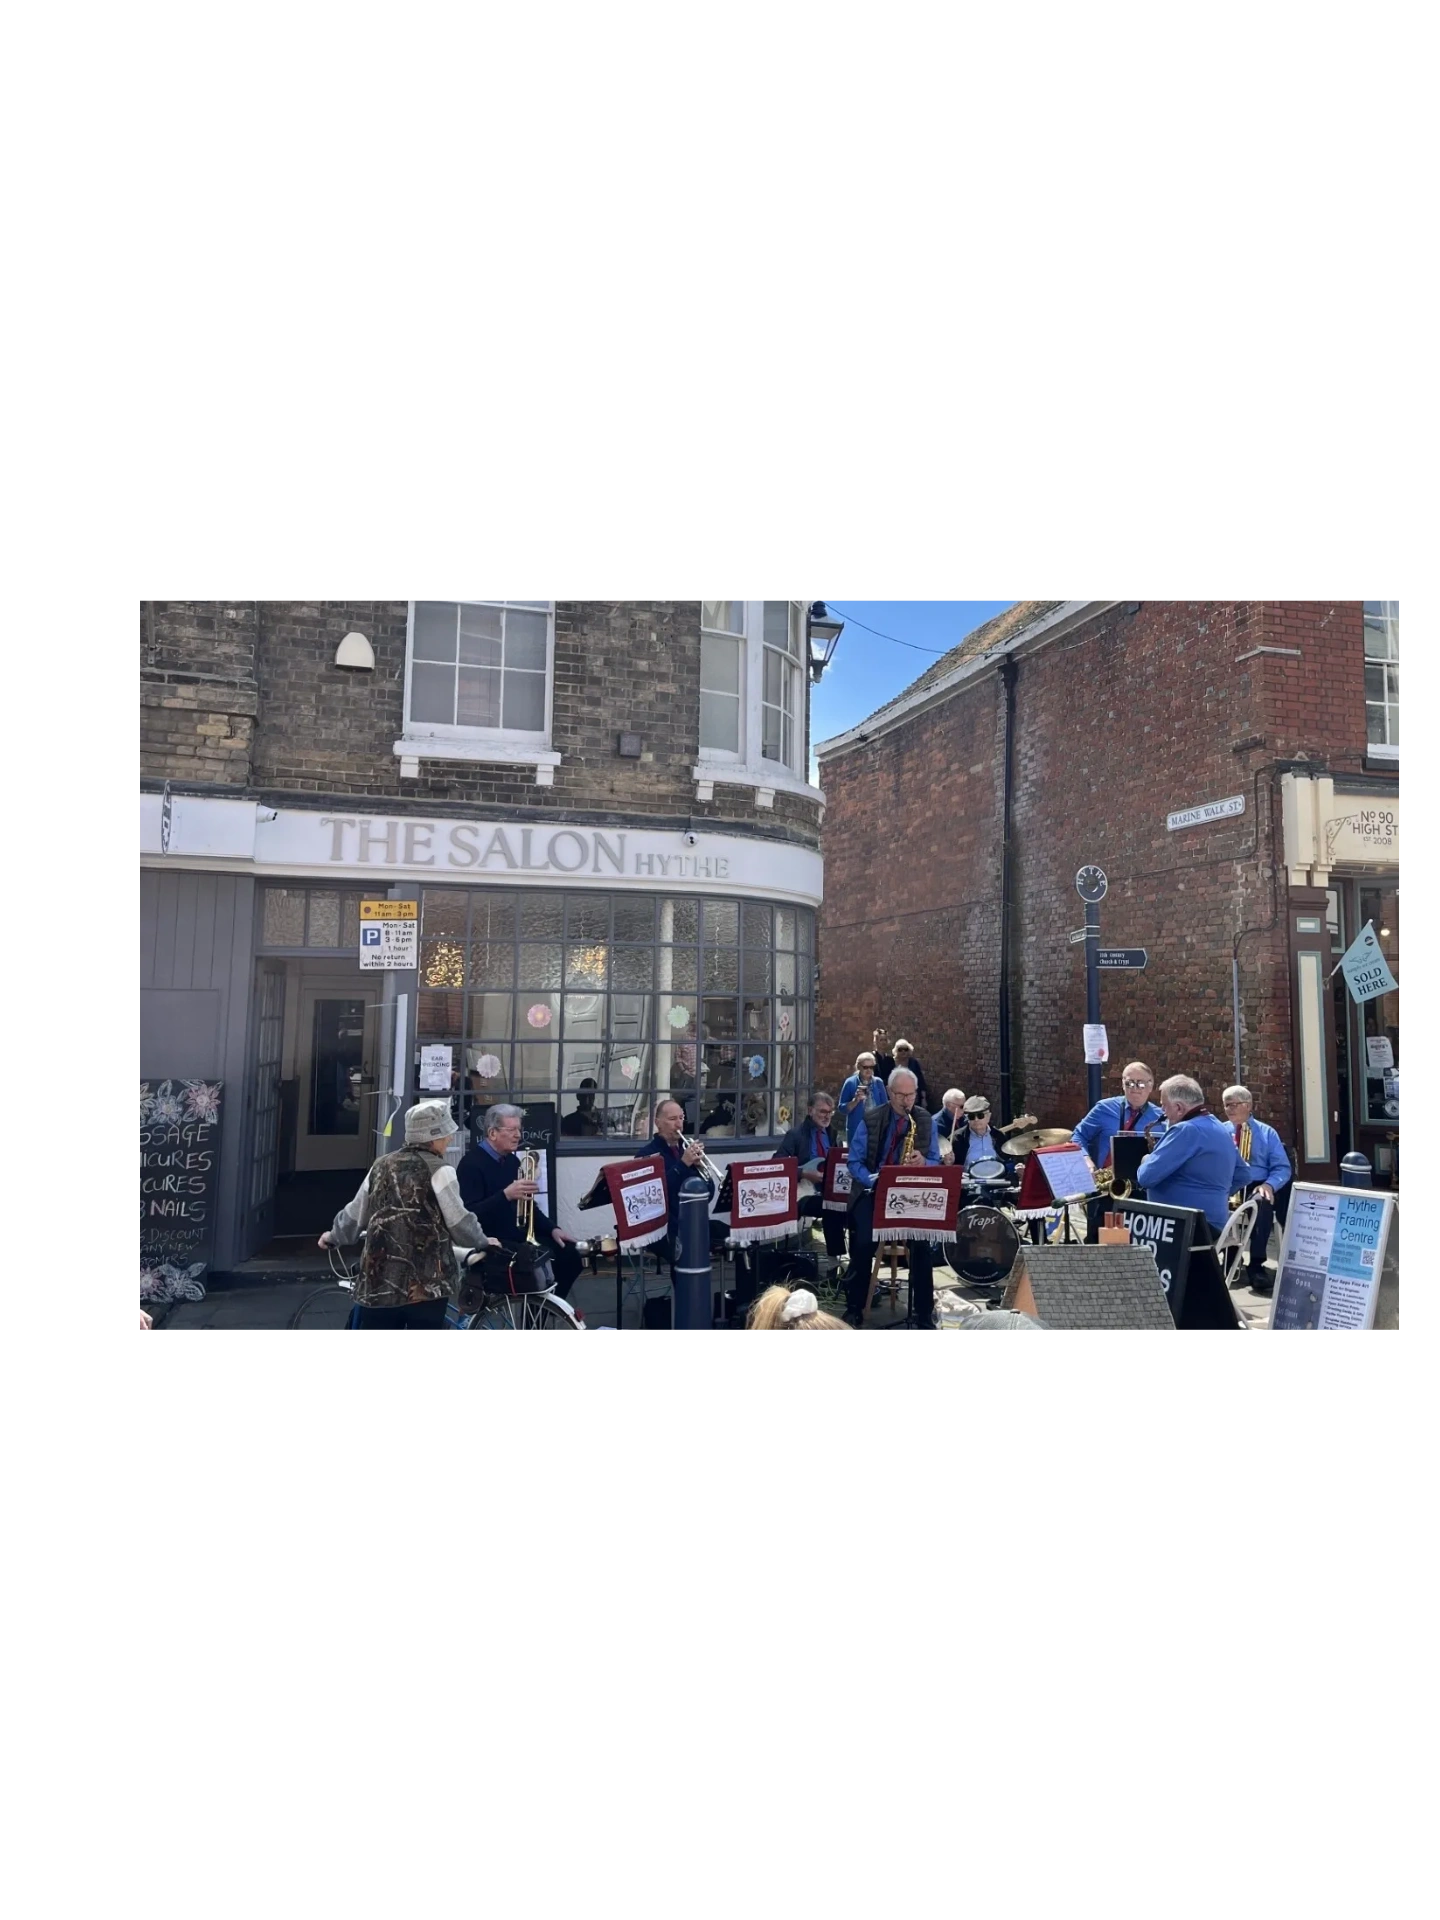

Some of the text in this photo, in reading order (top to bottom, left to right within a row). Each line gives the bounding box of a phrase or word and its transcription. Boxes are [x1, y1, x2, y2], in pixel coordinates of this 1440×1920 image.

[1171, 811, 1201, 826] MARINE
[1204, 804, 1225, 817] WALK
[1378, 811, 1394, 824] 90
[1352, 822, 1399, 836] HIGH ST
[320, 817, 730, 879] THE SALON HYTHE
[1373, 837, 1392, 845] 2008
[1077, 867, 1106, 887] HYTHE
[366, 930, 379, 944] P
[1353, 967, 1382, 985] SOLD
[1357, 978, 1388, 996] HERE
[1308, 1192, 1327, 1201] Open
[1347, 1198, 1378, 1214] Hythe
[967, 1213, 997, 1230] Traps
[1123, 1211, 1176, 1243] HOME
[1339, 1213, 1380, 1232] Framing
[1340, 1229, 1374, 1245] Centre
[169, 1242, 199, 1252] NEW
